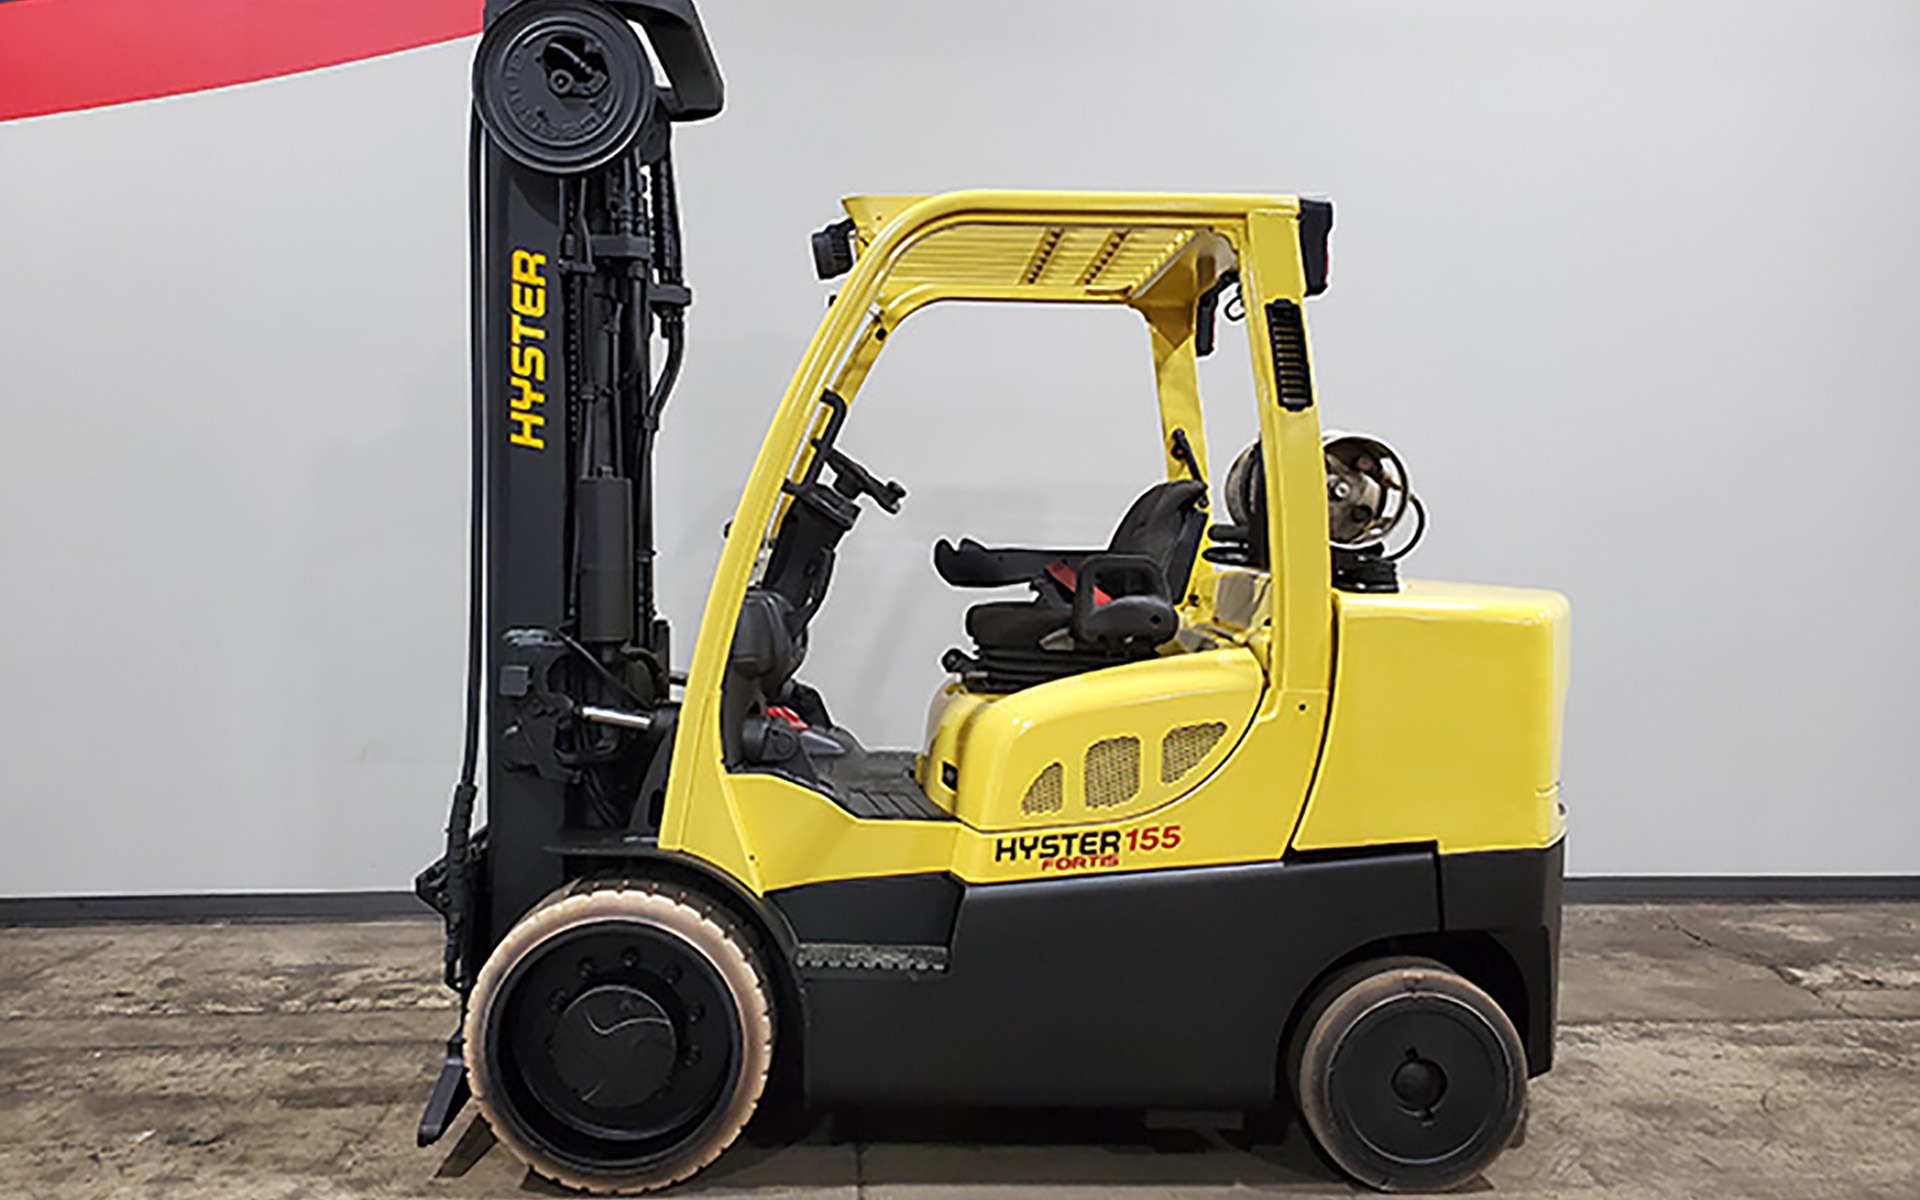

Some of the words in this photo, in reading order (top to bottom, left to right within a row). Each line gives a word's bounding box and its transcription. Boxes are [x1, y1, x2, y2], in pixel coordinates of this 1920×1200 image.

[510, 249, 547, 449] HYSTER
[995, 831, 1121, 862] HYSTER
[1126, 825, 1181, 851] 155
[1041, 854, 1119, 871] FORTIS
